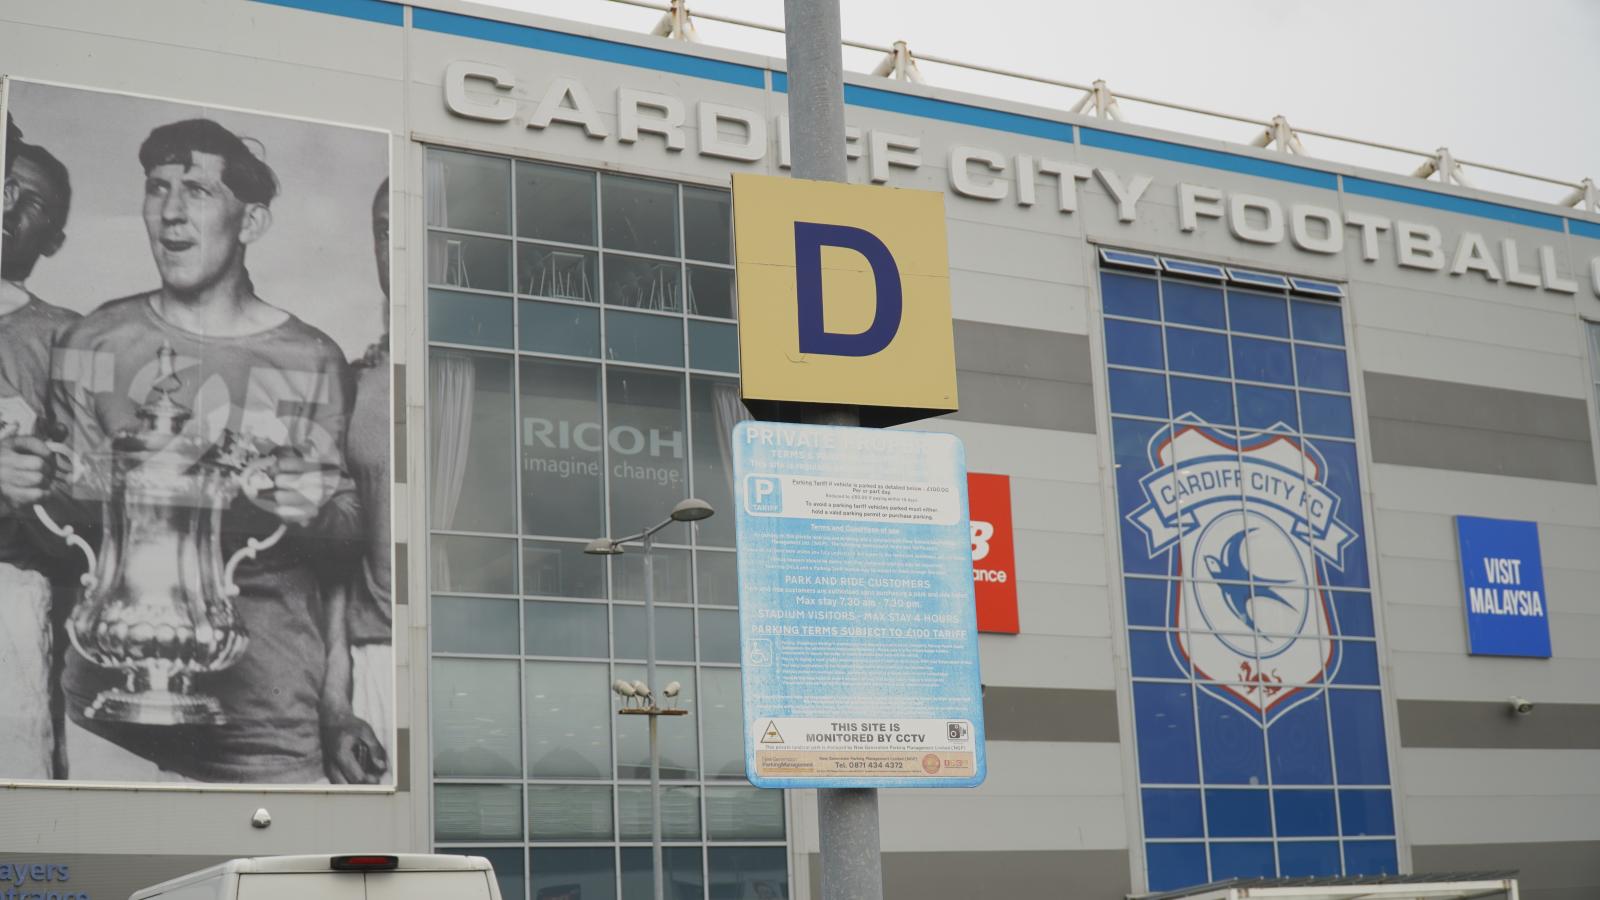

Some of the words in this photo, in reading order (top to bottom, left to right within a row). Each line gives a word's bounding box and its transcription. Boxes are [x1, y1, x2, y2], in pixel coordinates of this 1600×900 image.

[444, 60, 921, 185] CARDIF
[948, 145, 1153, 223] CITY
[1177, 181, 1579, 294] FOOTBALL
[793, 221, 903, 357] D
[523, 417, 684, 459] RICOH
[746, 426, 836, 449] PRIVATE
[756, 479, 774, 503] P
[792, 479, 812, 487] Parking
[1160, 469, 1242, 505] CARDIFF
[1251, 472, 1295, 500] CITY
[1299, 490, 1324, 518] FC
[785, 576, 812, 585] PARK
[815, 577, 837, 585] AND
[840, 577, 864, 586] RIDE
[868, 578, 931, 588] CUSTOMERS
[1483, 557, 1521, 584] VISIT
[796, 596, 815, 605] Max
[818, 596, 837, 607] stay
[1469, 587, 1543, 616] MALAYSIA
[758, 610, 805, 619] STADIUM
[807, 611, 856, 620] VISITORS
[864, 612, 886, 621] MAX
[888, 613, 912, 621] STAY
[924, 614, 960, 623] HOURS
[752, 625, 799, 635] PARKING
[802, 626, 838, 635] TERMS
[840, 627, 888, 637] SUBJECT
[888, 628, 902, 637] TO
[932, 629, 967, 639] TARIFF
[806, 734, 873, 742] MONITORED
[878, 734, 892, 742] BY
[896, 734, 925, 743] CCTV
[831, 723, 857, 731] THIS
[861, 723, 886, 732] SITE
[890, 723, 900, 732] IS
[0, 863, 70, 887] ayers
